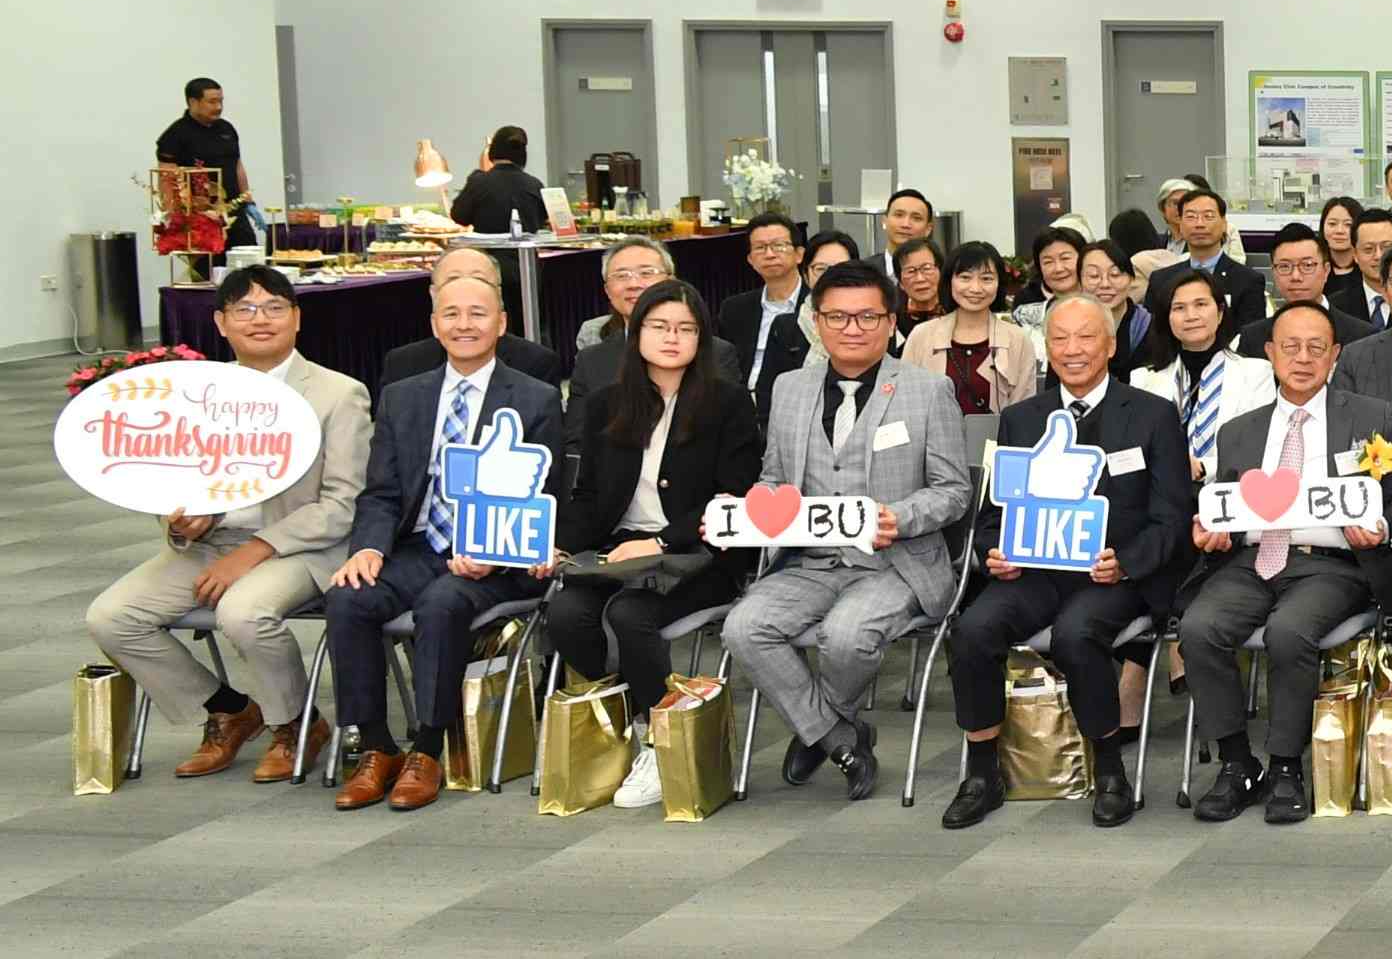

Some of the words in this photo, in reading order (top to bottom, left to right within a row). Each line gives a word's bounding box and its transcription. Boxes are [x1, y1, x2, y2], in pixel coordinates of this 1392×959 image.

[182, 383, 279, 427] happy
[84, 410, 292, 479] thanksgiving
[716, 504, 739, 537] I
[808, 500, 865, 538] BU
[1211, 489, 1236, 523] I
[1308, 481, 1368, 520] BU
[465, 503, 542, 559] LIKE
[1012, 506, 1095, 561] LIKE
